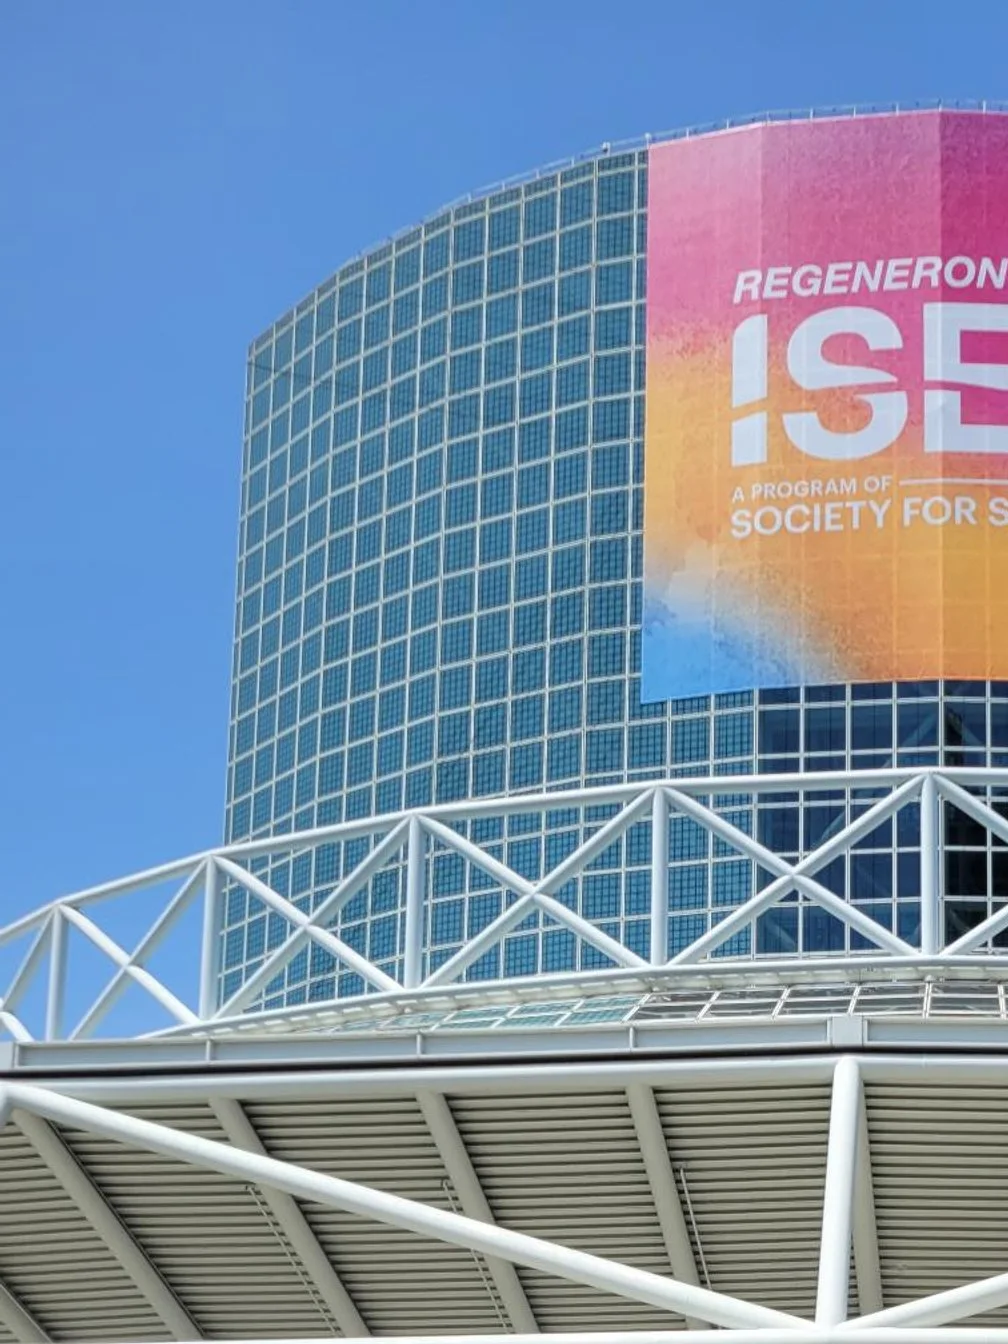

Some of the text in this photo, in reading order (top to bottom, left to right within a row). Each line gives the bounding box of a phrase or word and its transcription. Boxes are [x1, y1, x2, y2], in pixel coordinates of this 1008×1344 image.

[734, 256, 1008, 302] REGENERON
[732, 476, 892, 501] A PROGRAM OF
[731, 500, 890, 538] SOCIETY
[903, 497, 978, 526] FOR
